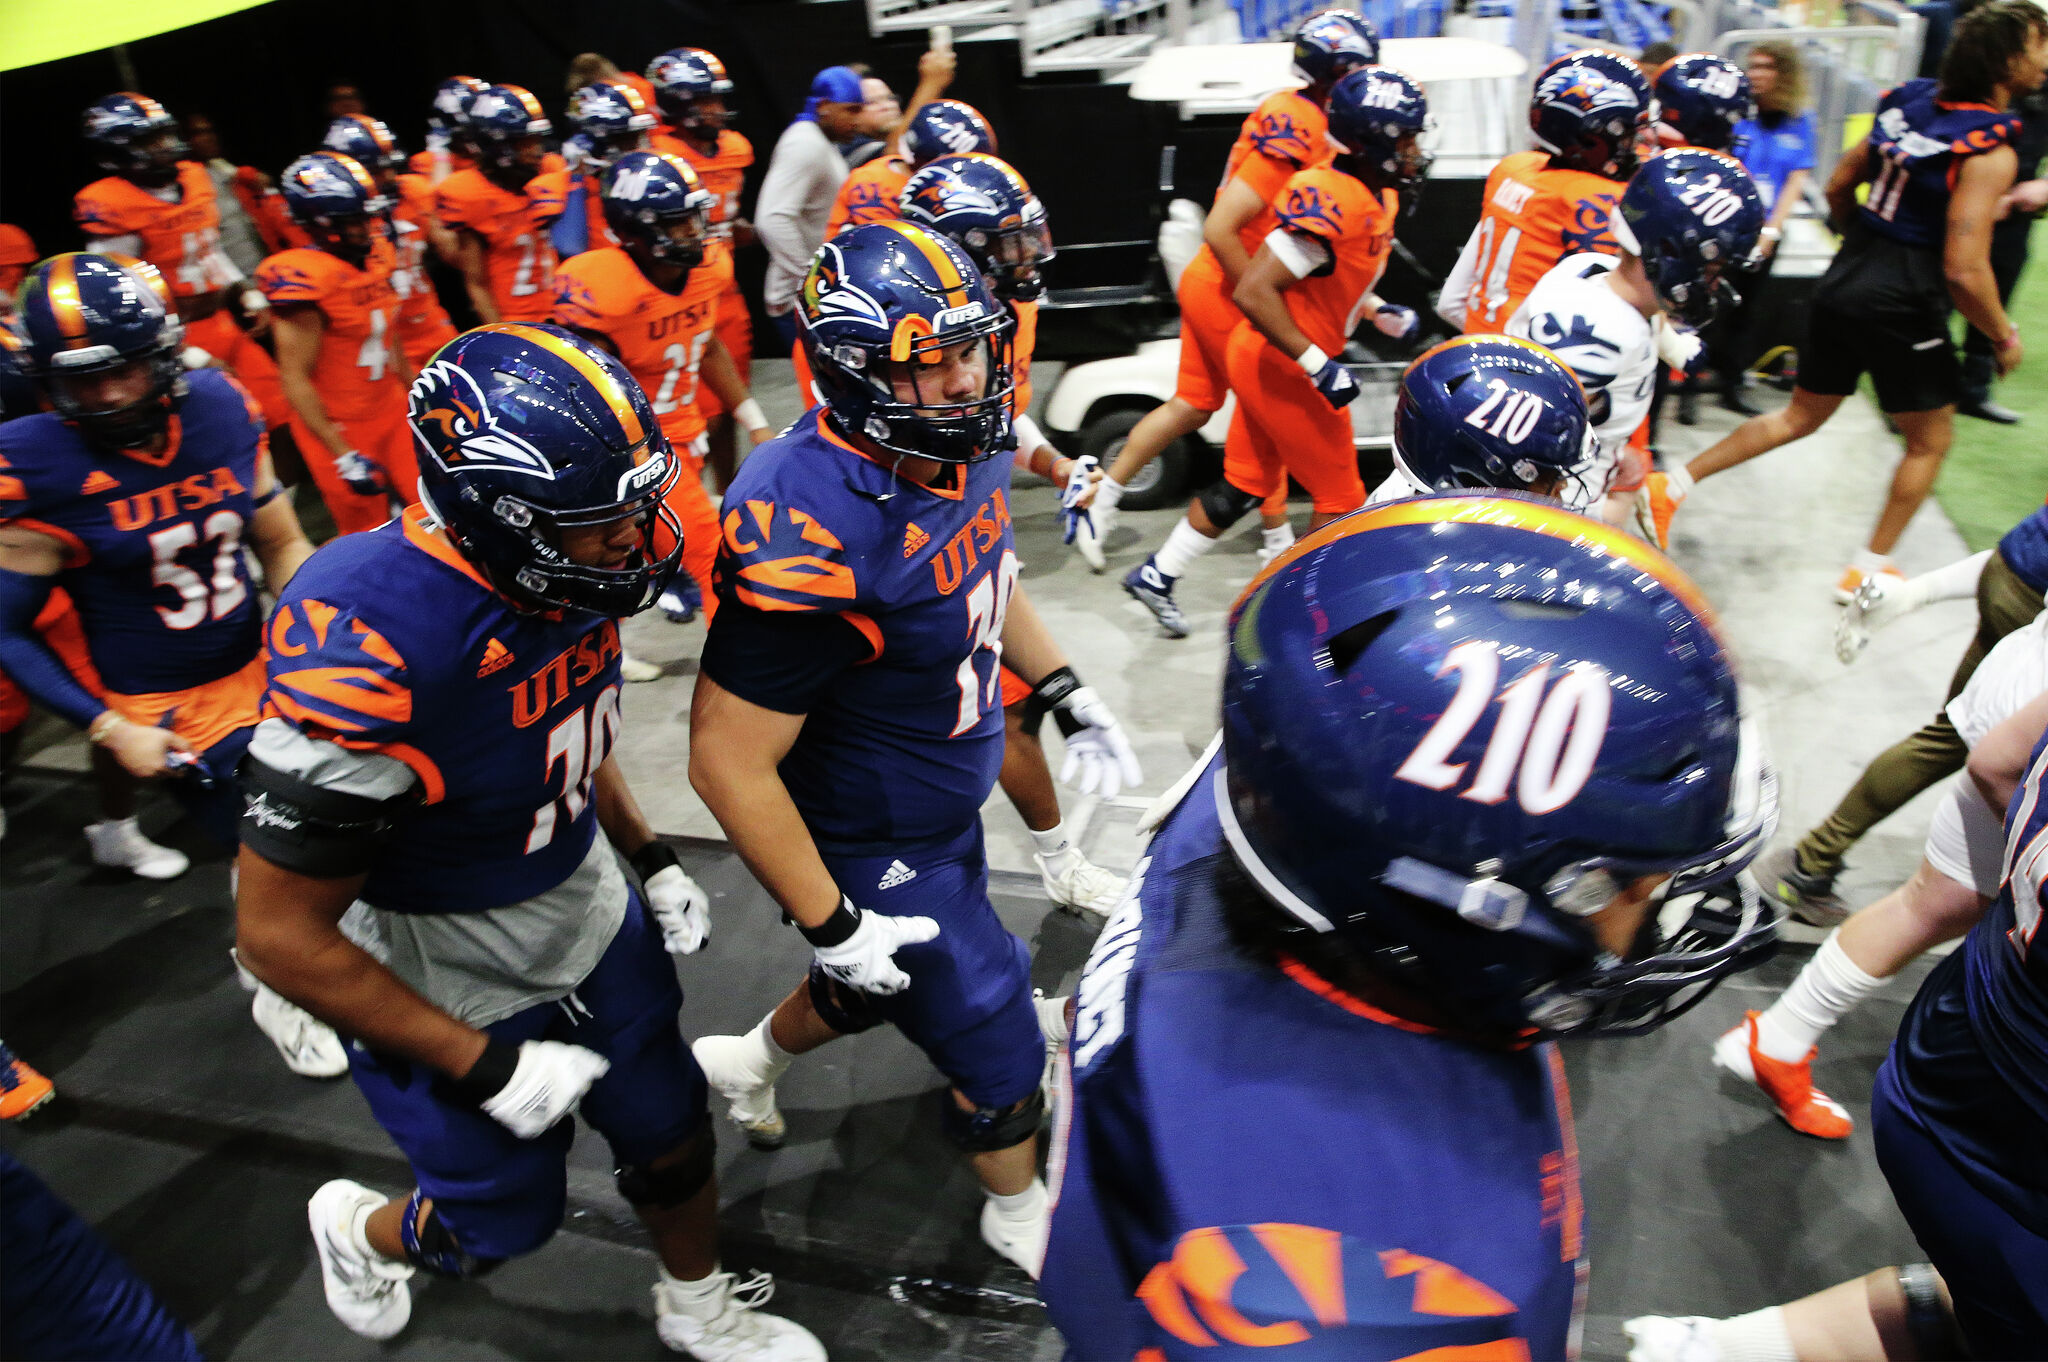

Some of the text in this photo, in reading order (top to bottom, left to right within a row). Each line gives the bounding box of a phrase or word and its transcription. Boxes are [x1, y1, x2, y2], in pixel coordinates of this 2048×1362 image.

[1678, 172, 1743, 227] 210
[945, 305, 985, 326] UTSA
[1463, 377, 1544, 445] 210
[105, 467, 247, 531] UTSA
[631, 459, 667, 489] UTSA
[147, 510, 248, 631] 52
[929, 487, 1013, 597] UTSA
[506, 618, 622, 730] UTSA
[1393, 640, 1613, 816] 210
[522, 683, 622, 856] 70
[877, 869, 918, 891] adidas
